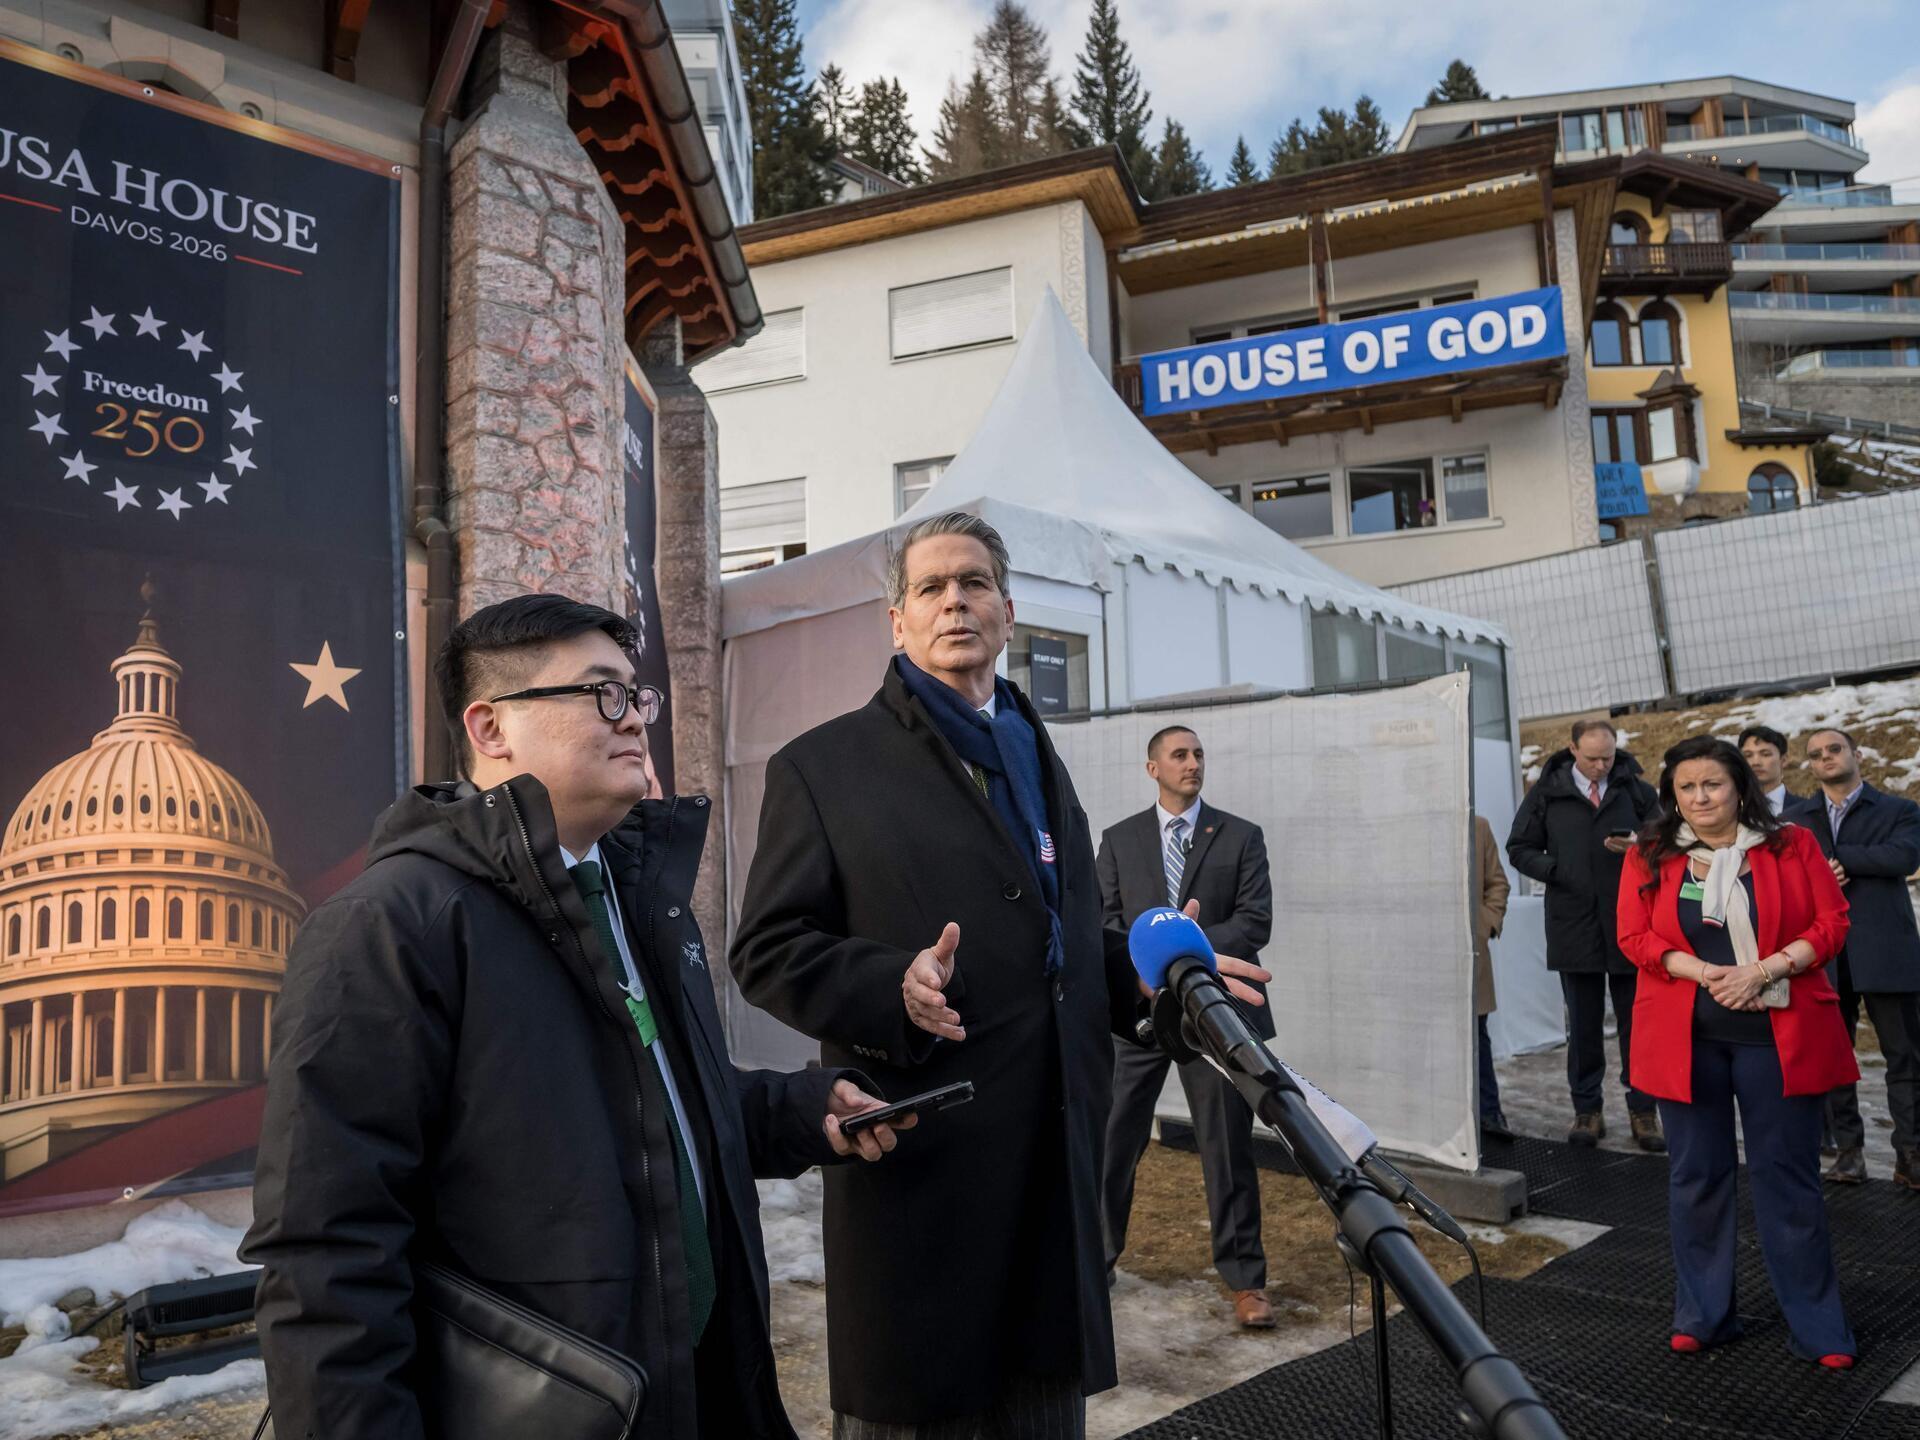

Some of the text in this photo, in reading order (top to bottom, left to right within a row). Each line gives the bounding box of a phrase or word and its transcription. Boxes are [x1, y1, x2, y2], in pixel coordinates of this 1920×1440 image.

[70, 205, 227, 261] DAVOS 2026
[110, 160, 318, 254] HOUSE
[1157, 304, 1547, 403] HOUSE OF GOD
[83, 369, 210, 414] Freedom
[90, 402, 205, 457] 250
[1050, 656, 1065, 665] ONLY
